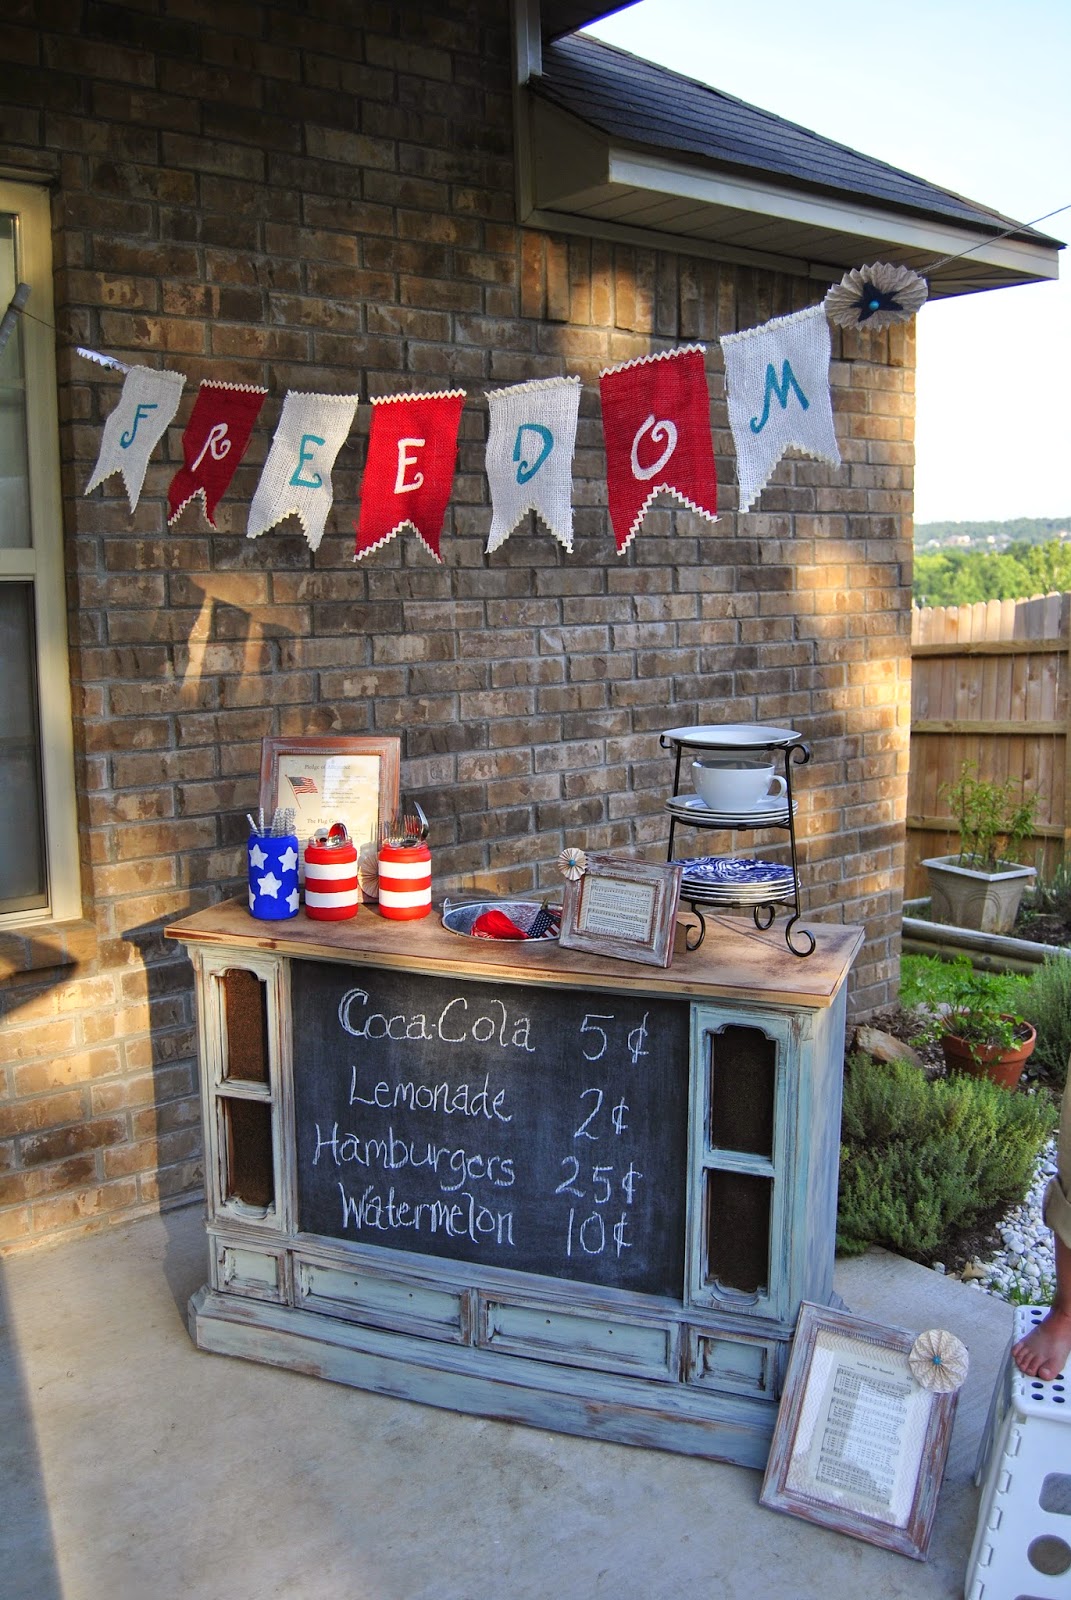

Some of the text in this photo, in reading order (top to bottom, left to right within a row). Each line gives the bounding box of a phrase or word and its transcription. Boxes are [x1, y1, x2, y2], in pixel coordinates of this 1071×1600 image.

[120, 358, 809, 494] FREEDOM
[349, 1065, 513, 1122] Lemonade
[312, 1121, 516, 1192] Hamburgers
[337, 1181, 516, 1246] Watermelon
